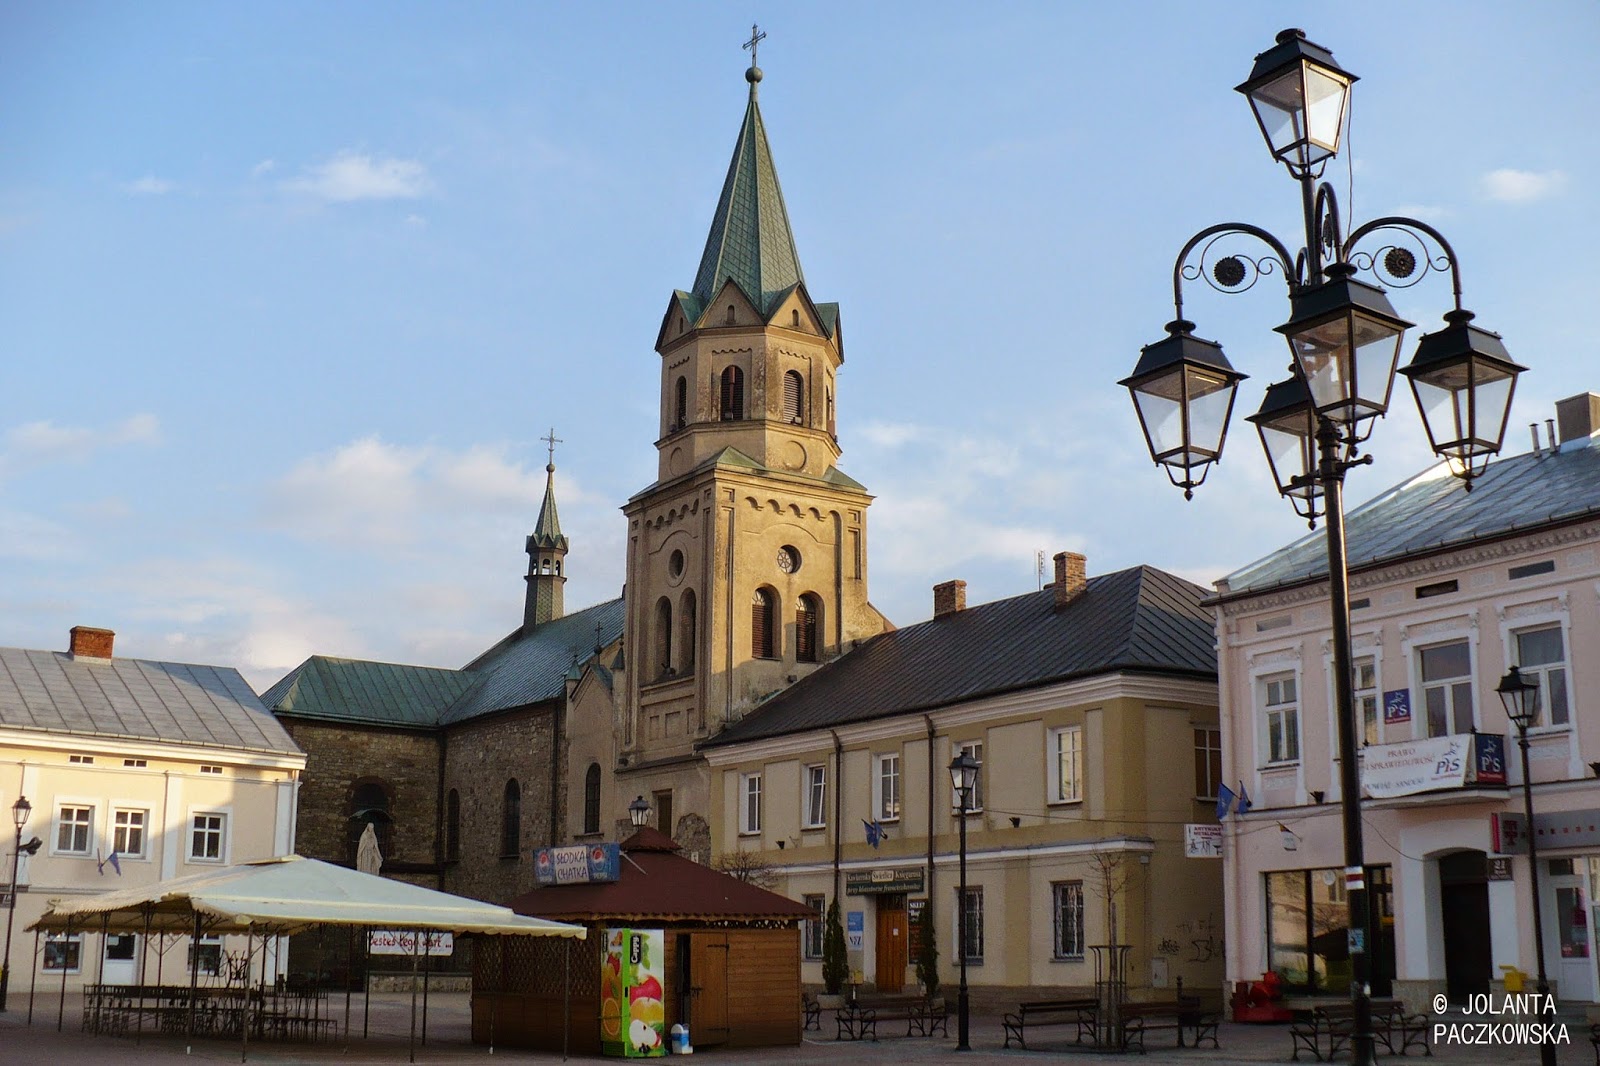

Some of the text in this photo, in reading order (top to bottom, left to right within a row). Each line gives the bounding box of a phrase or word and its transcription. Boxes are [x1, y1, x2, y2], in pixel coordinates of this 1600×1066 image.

[1387, 748, 1416, 758] PRAWO
[556, 850, 585, 865] SŁODKA
[557, 867, 587, 880] CHATKA
[631, 935, 640, 964] Cappy
